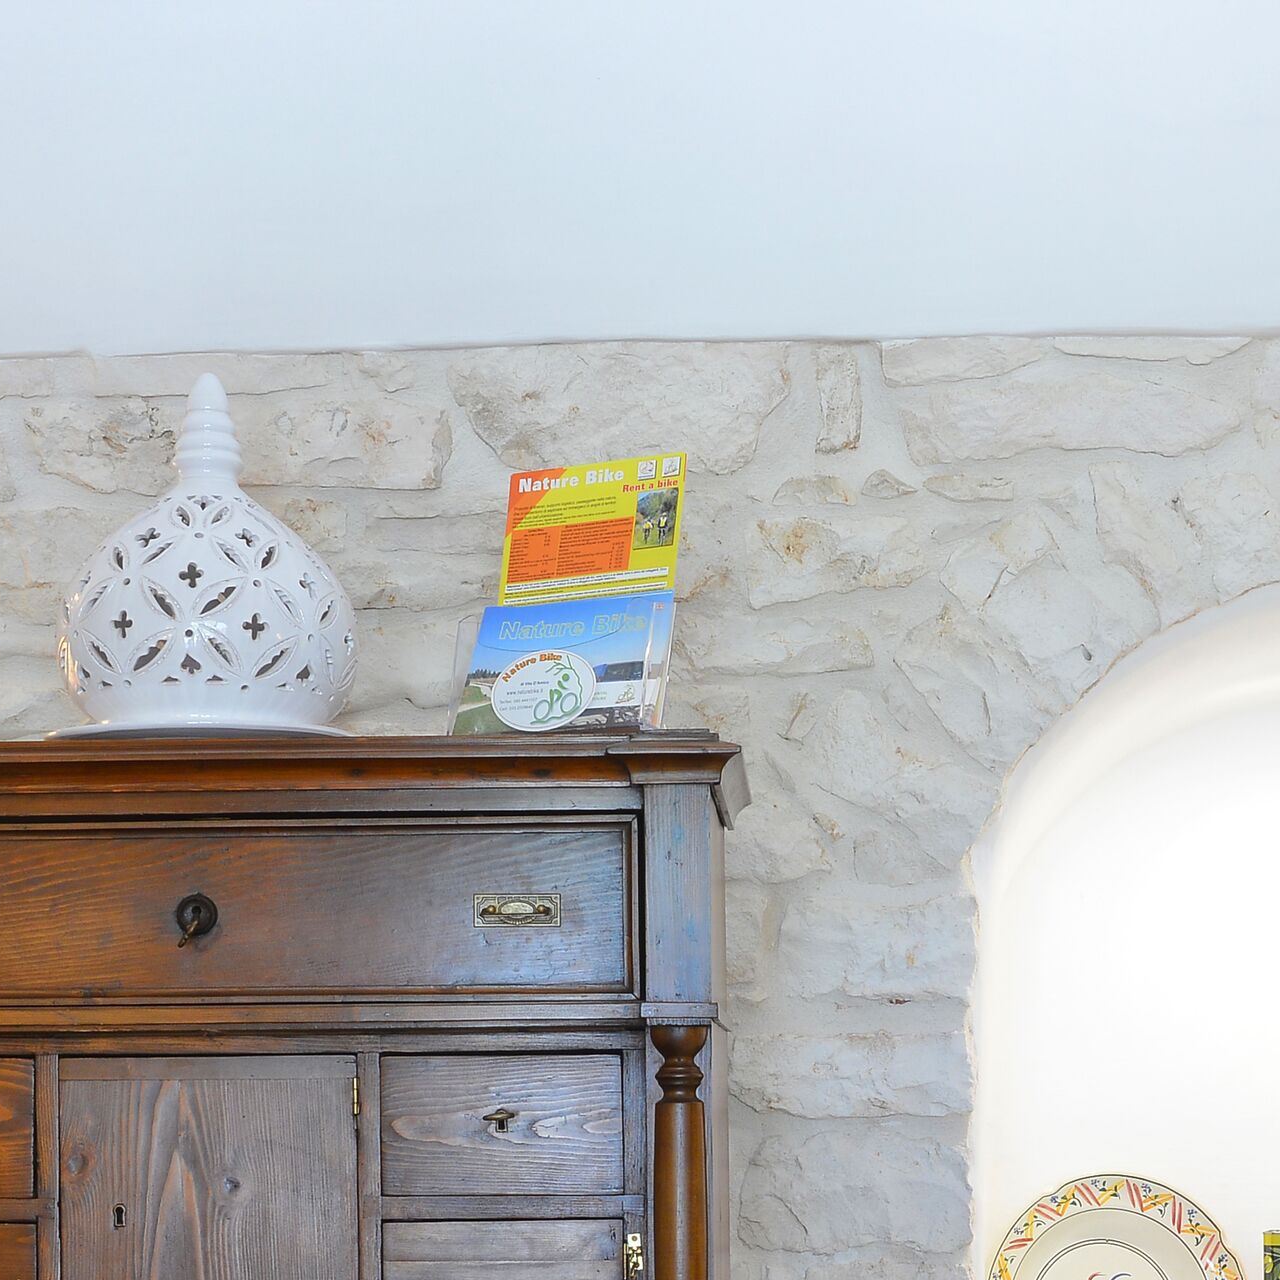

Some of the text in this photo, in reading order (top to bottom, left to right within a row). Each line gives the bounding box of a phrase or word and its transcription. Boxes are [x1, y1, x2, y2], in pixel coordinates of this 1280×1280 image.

[518, 468, 625, 493] Nature Bike
[622, 483, 646, 493] Rent
[656, 478, 679, 488] bike
[498, 611, 648, 641] Nature Bike
[501, 652, 562, 683] Nature Bike
